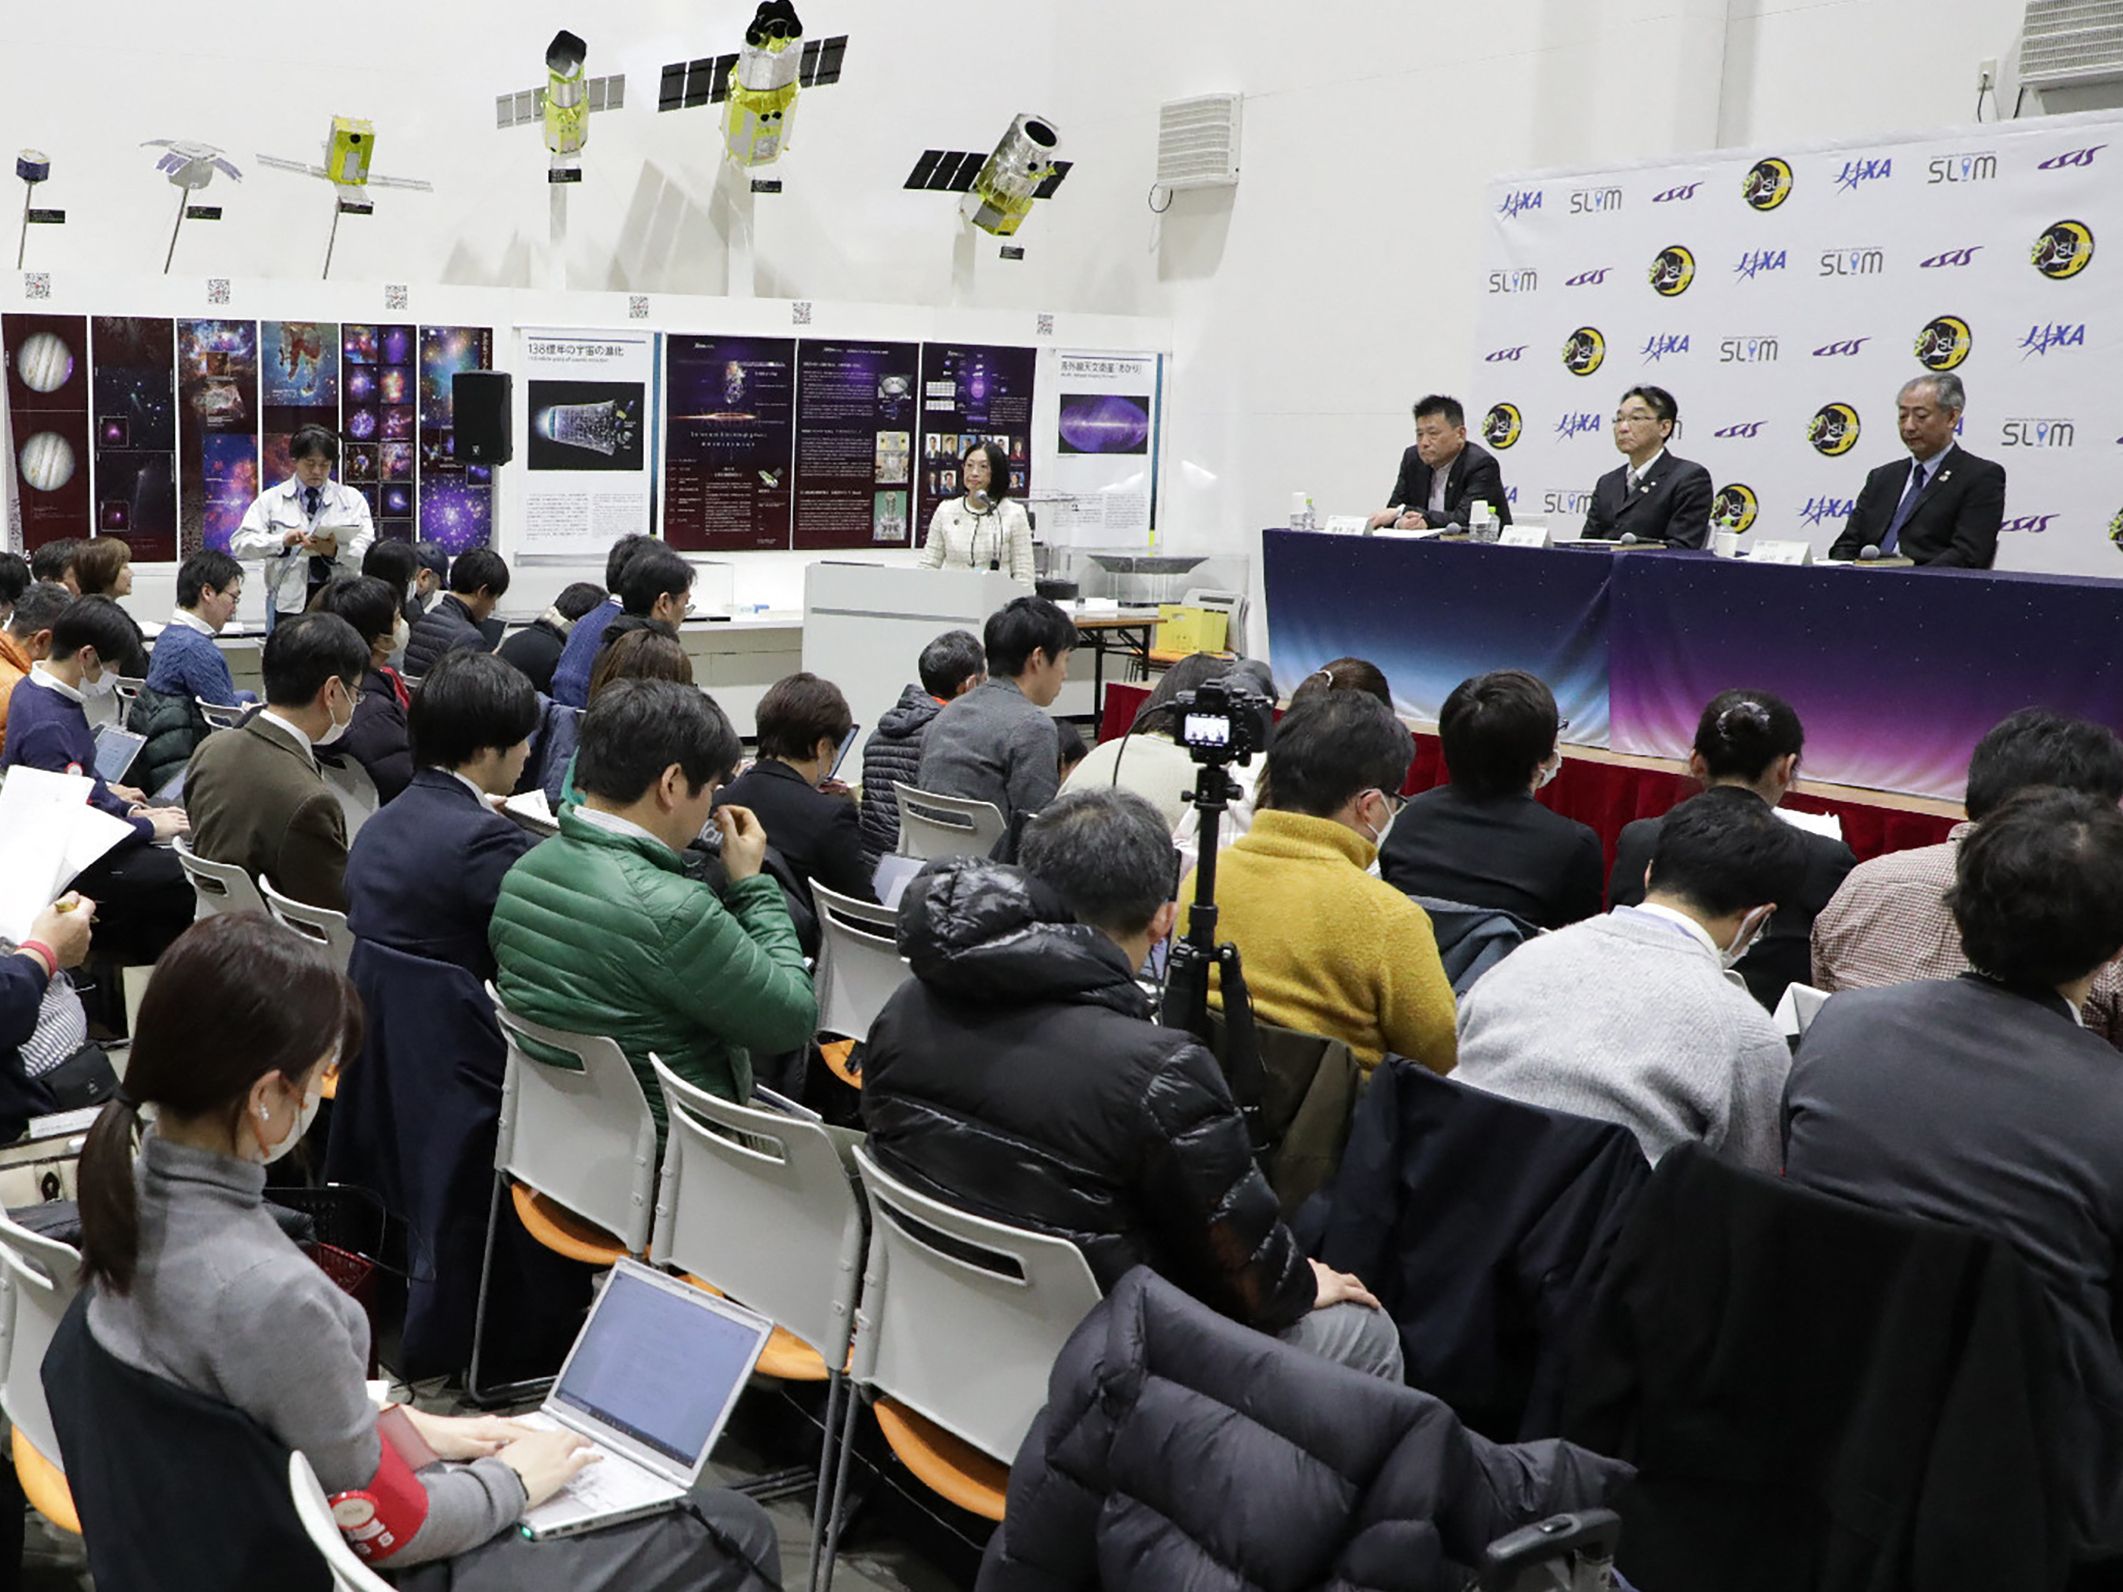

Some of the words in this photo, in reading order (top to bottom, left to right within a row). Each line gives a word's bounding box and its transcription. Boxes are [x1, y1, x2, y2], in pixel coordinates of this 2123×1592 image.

[1833, 158, 1892, 194] JAXA
[1498, 190, 1543, 221] JAXA
[1734, 248, 1787, 285] JAXA
[1640, 332, 1689, 366] JAXA
[2017, 321, 2085, 362] JAXA
[1554, 412, 1600, 443] JAXA
[2001, 422, 2074, 447] SLIM
